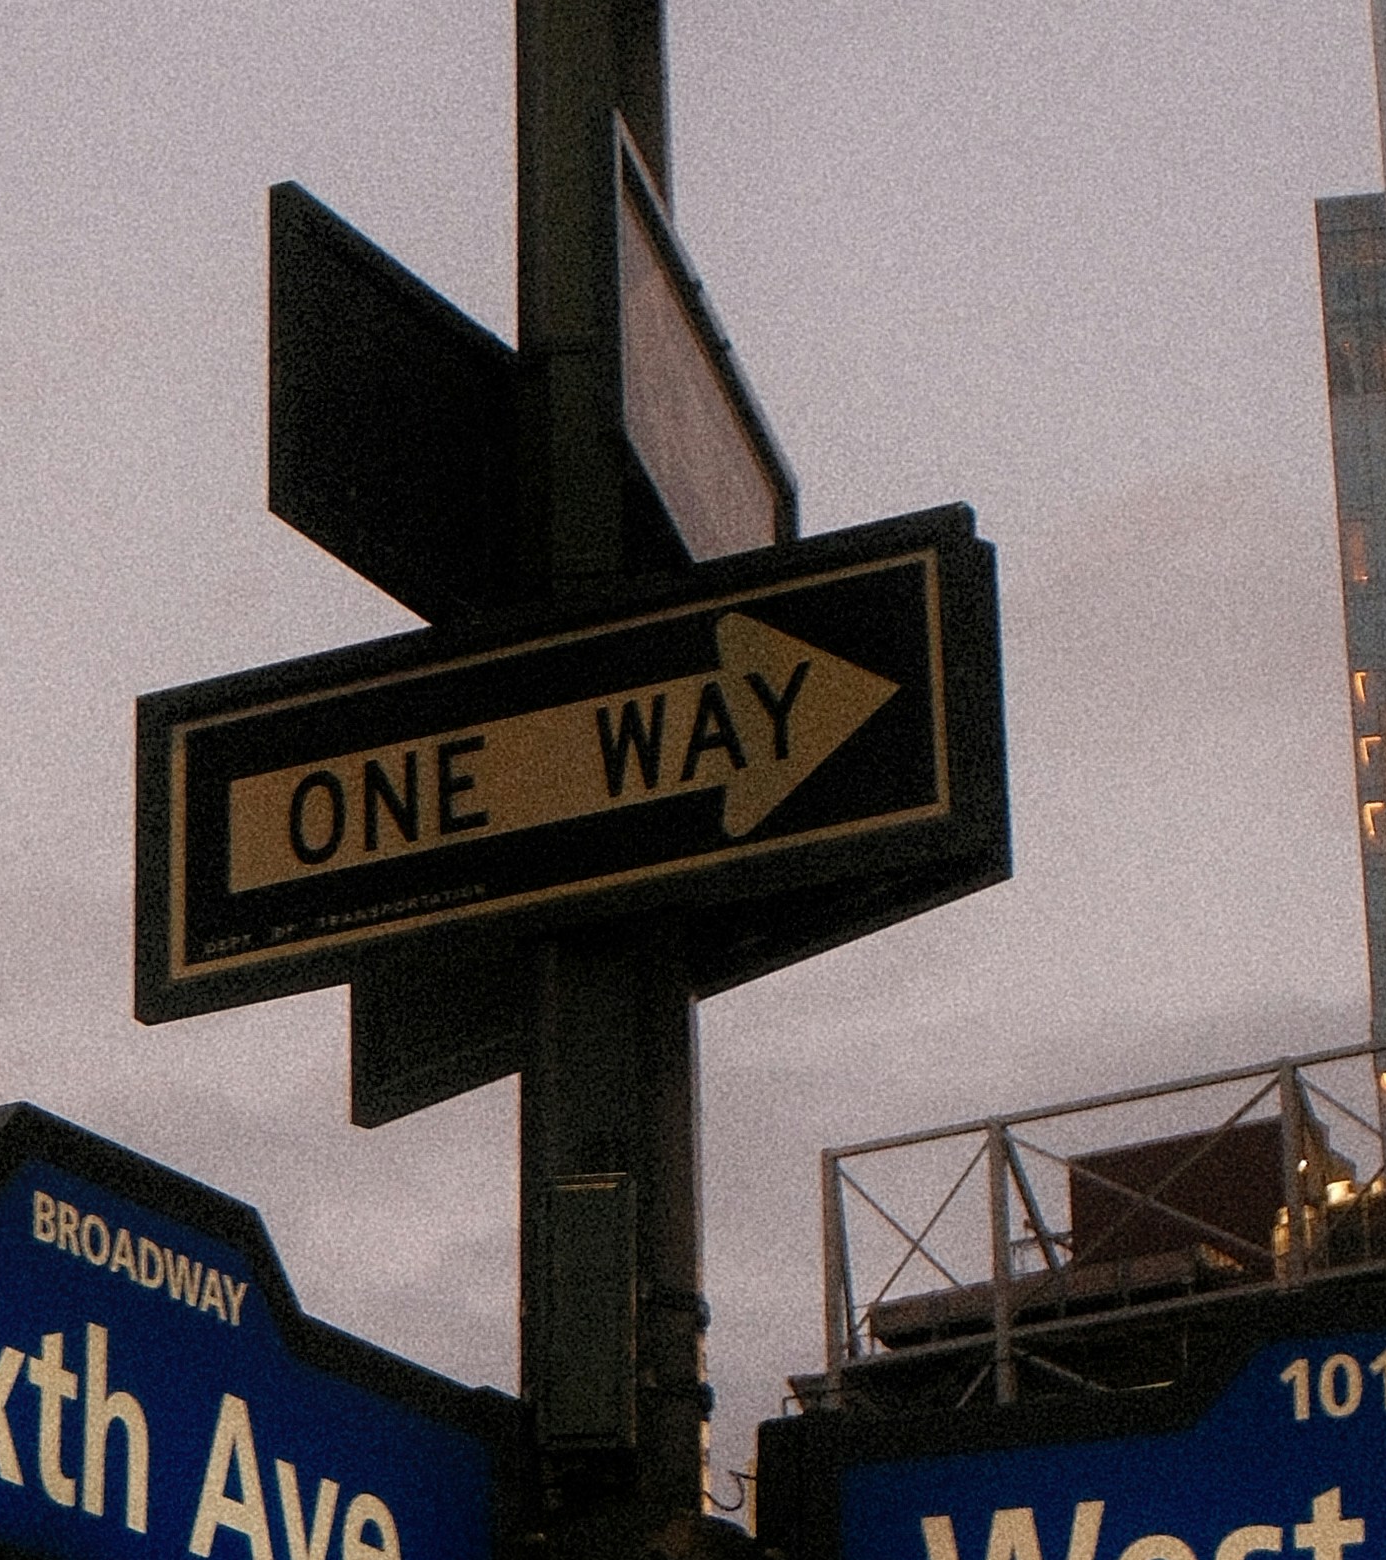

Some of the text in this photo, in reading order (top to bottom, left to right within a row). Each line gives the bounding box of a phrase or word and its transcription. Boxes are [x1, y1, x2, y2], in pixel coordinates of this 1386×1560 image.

[289, 661, 811, 866] ONE WAY
[33, 1190, 248, 1326] BROADWAY
